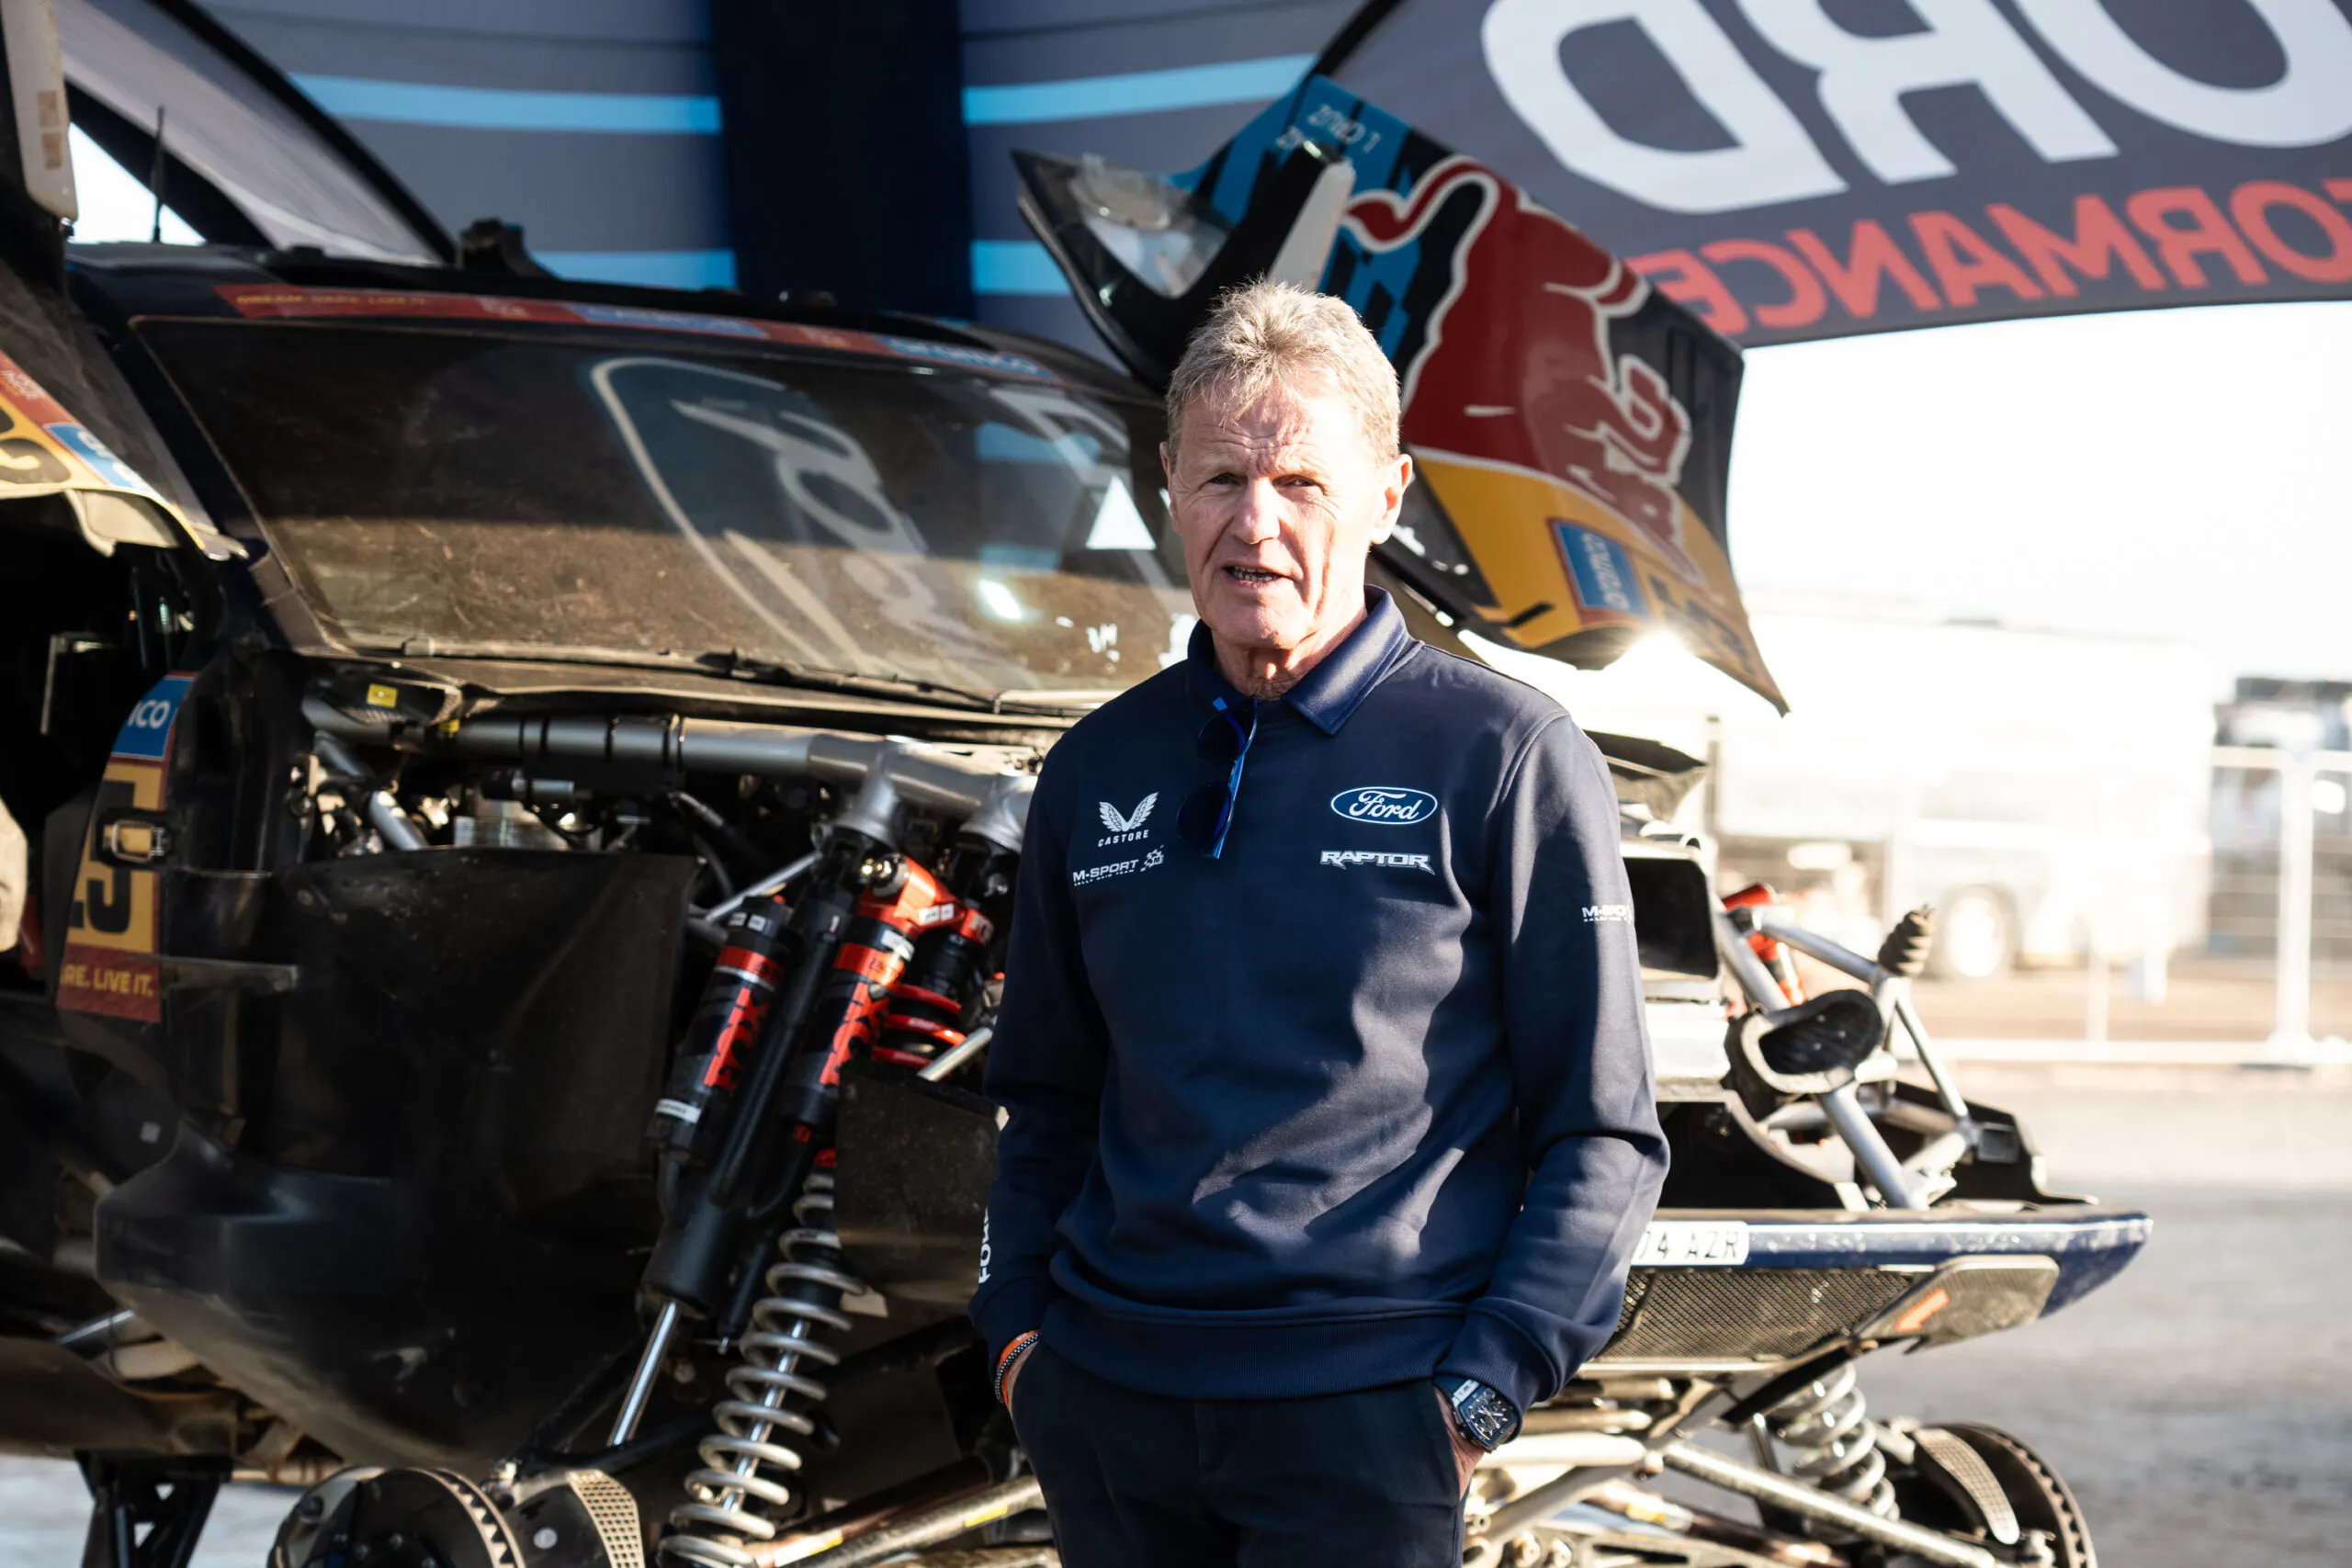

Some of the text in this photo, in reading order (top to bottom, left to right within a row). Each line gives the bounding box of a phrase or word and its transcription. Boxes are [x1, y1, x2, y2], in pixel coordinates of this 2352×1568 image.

[1349, 790, 1423, 819] Ford
[1098, 829, 1149, 847] CASTORE
[1320, 851, 1435, 875] RAPTOR
[93, 967, 130, 996] LIVE
[1684, 1229, 1740, 1259] AZR
